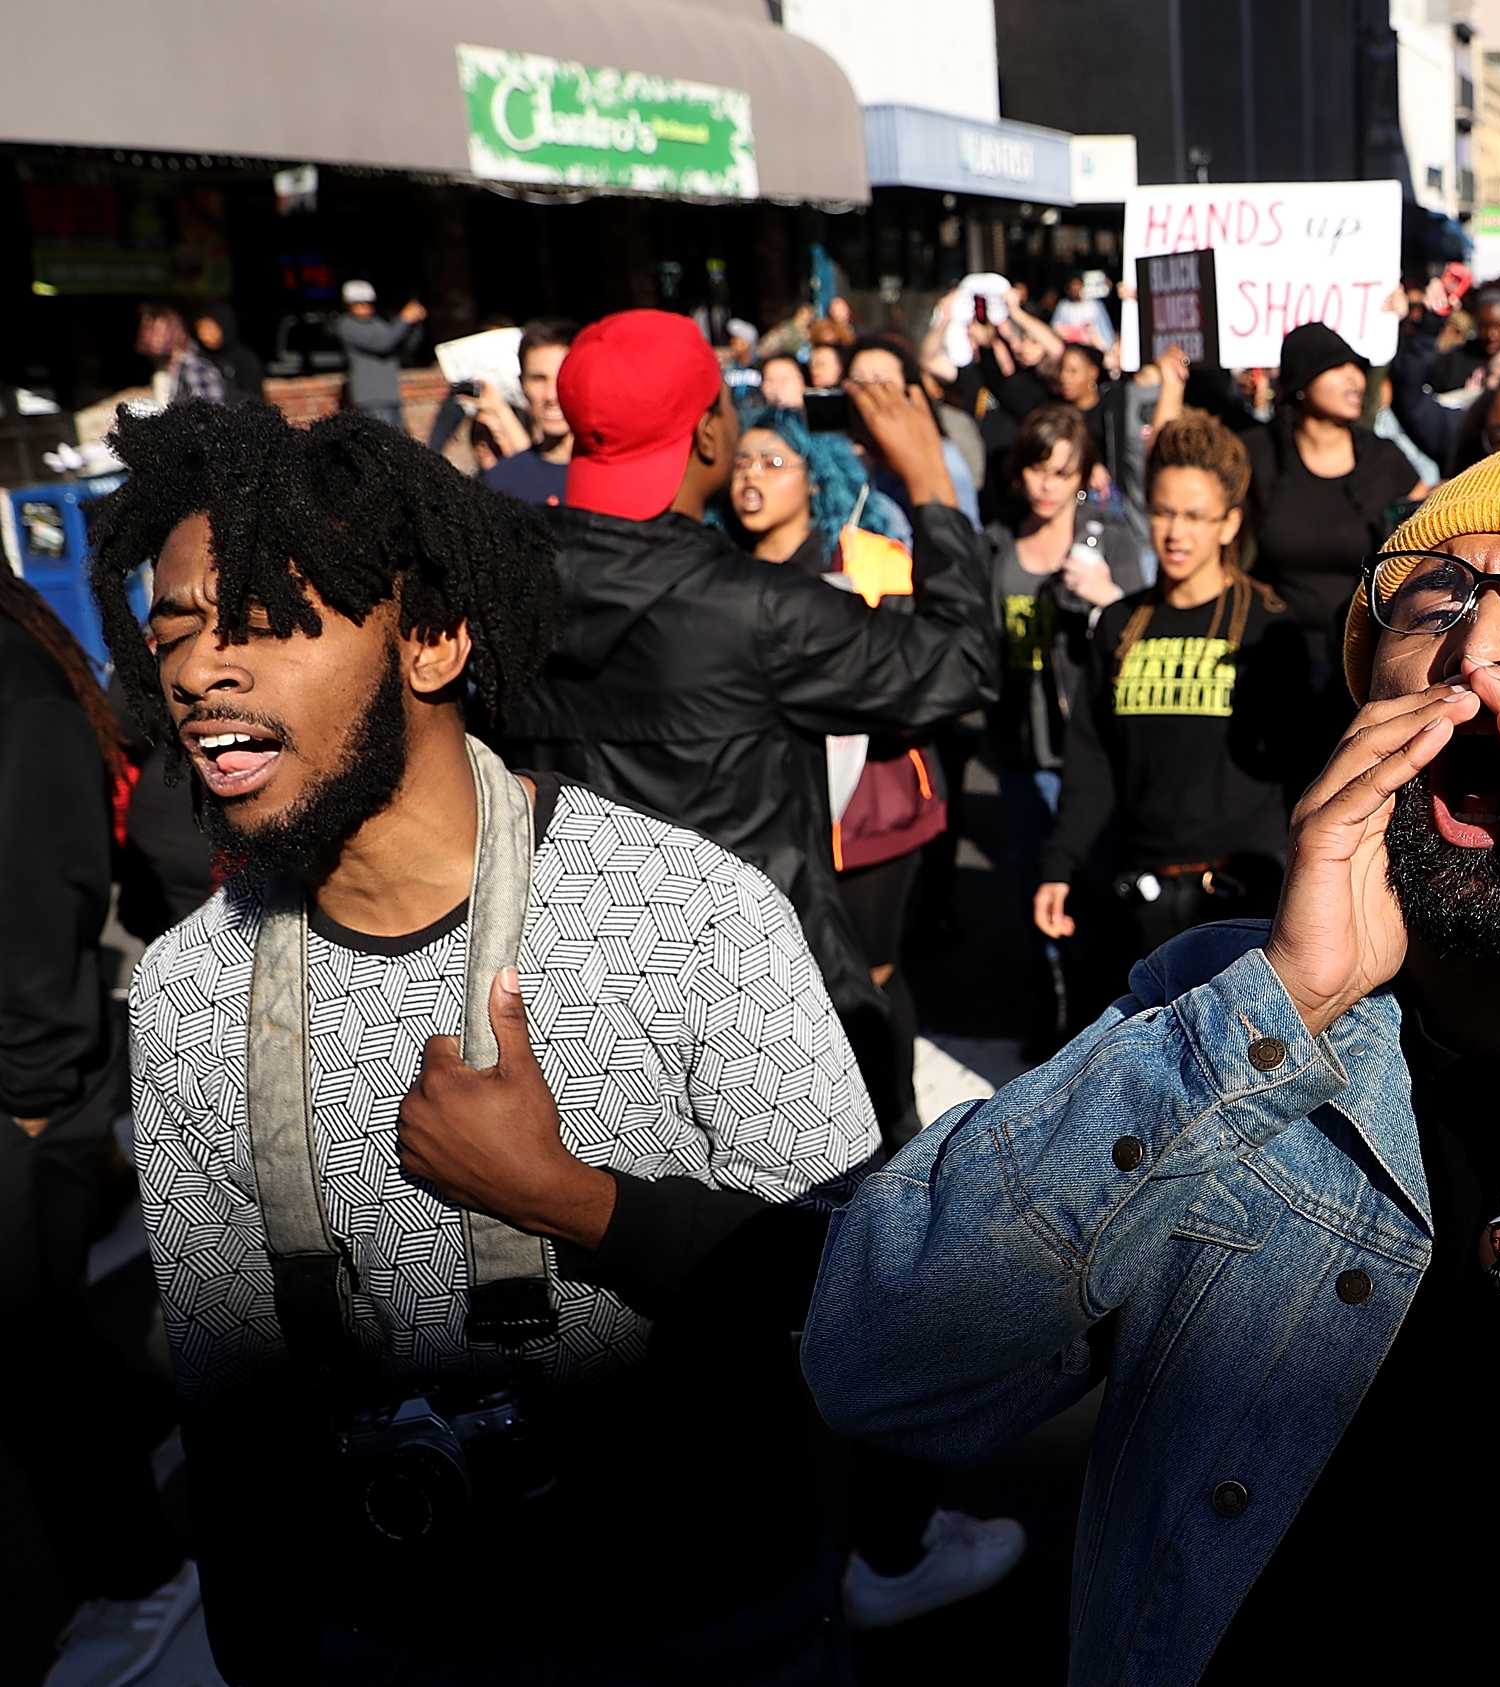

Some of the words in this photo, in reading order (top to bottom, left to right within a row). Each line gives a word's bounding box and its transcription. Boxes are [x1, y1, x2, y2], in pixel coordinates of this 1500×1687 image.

[1144, 199, 1285, 253] HANDS
[1305, 217, 1361, 257] up
[1229, 279, 1384, 341] SHOOT
